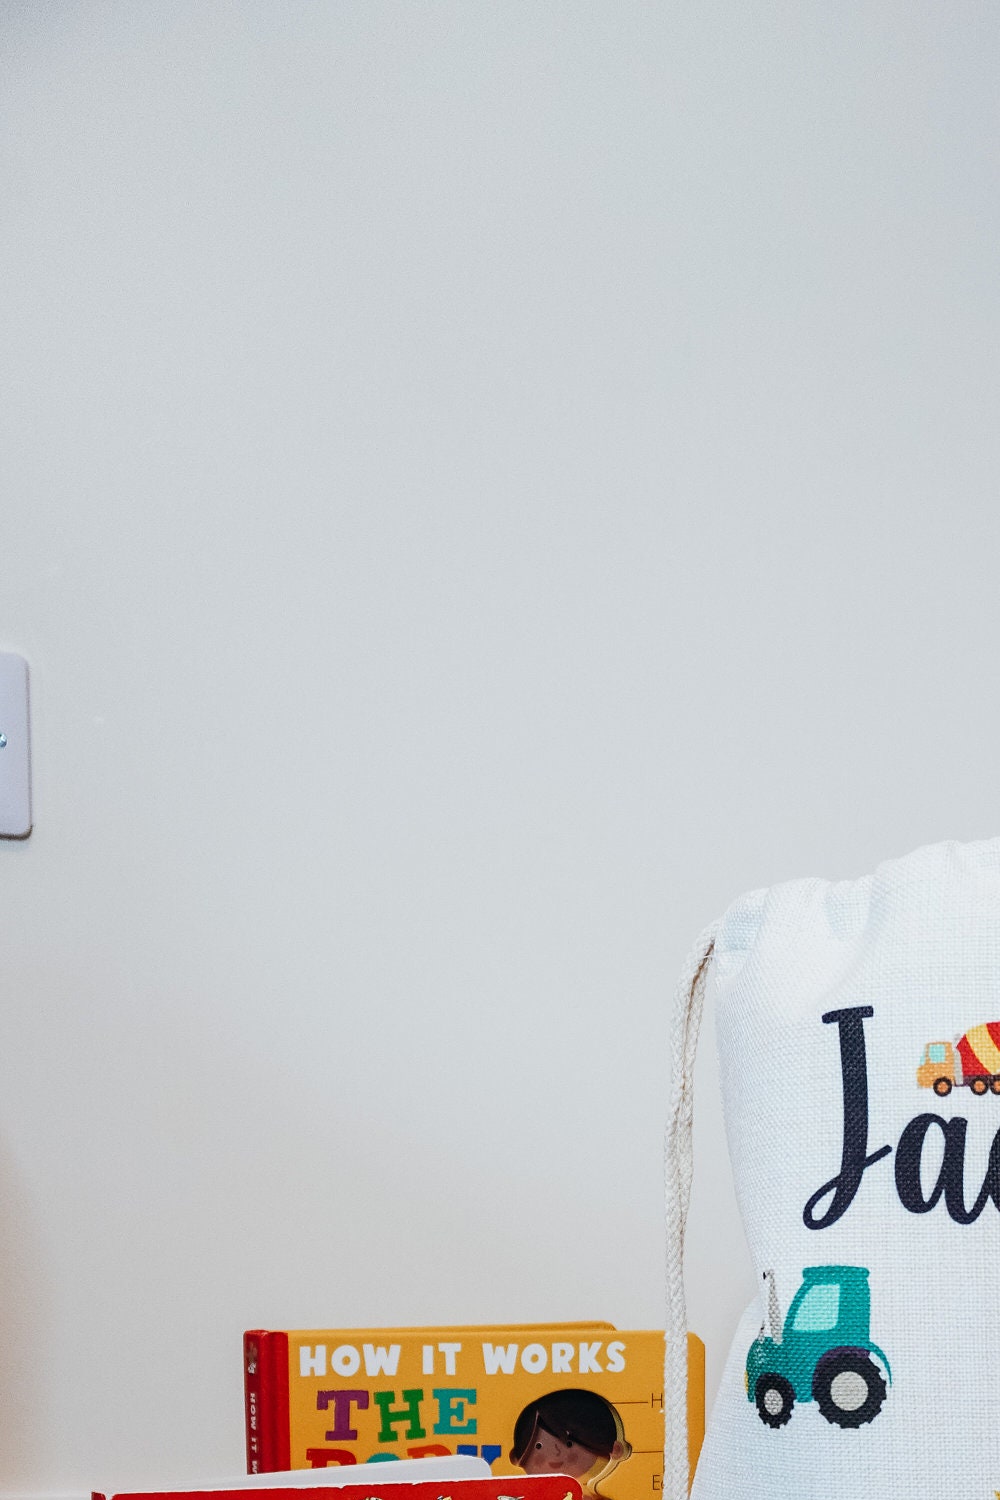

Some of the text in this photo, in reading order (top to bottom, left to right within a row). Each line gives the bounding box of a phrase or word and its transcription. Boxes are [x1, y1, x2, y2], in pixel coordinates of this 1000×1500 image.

[300, 1340, 626, 1377] HOW IT WORKS
[316, 1388, 477, 1443] THE
